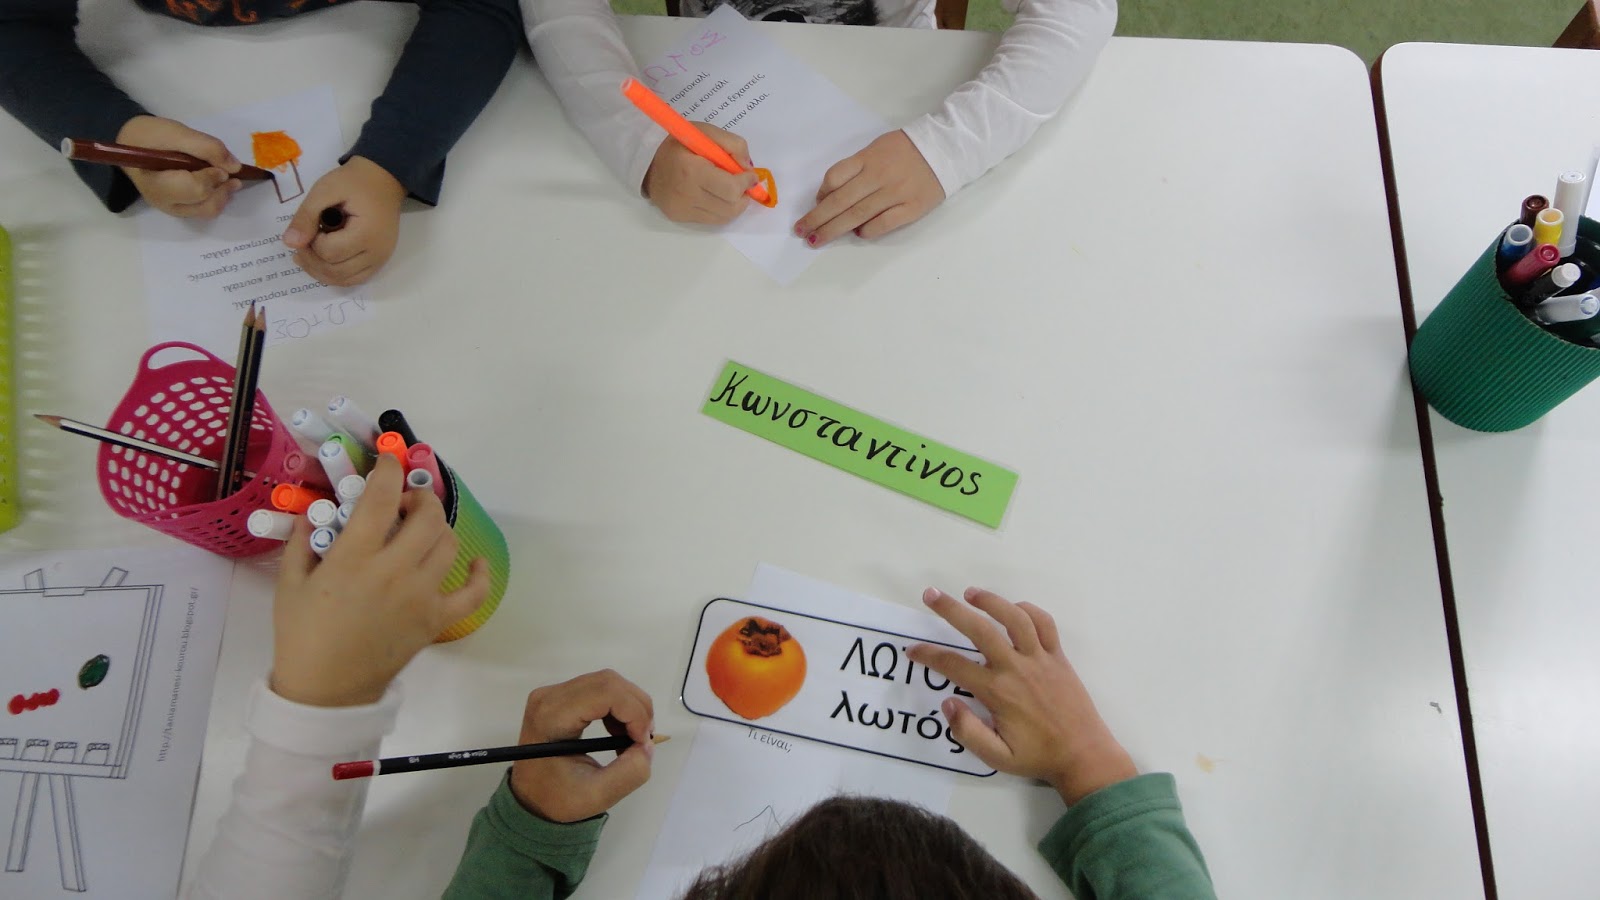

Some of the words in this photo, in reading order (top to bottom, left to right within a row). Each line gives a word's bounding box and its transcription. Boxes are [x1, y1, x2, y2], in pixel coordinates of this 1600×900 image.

[670, 71, 710, 104] πορτοκαλί,
[689, 101, 700, 113] με
[699, 78, 729, 103] κουτάλι
[704, 109, 719, 123] εσύ
[718, 101, 730, 110] να
[727, 72, 766, 102] ξεχαστείς,
[746, 92, 770, 112] άλλοι.
[240, 261, 254, 269] να
[255, 255, 275, 266] εσύ
[222, 277, 263, 293] κουτάλι
[265, 272, 278, 282] με
[710, 371, 982, 496] Κωνσταντίνος
[830, 690, 965, 754] λωτός
[748, 726, 757, 739] Τι
[760, 733, 792, 753] είναι;
